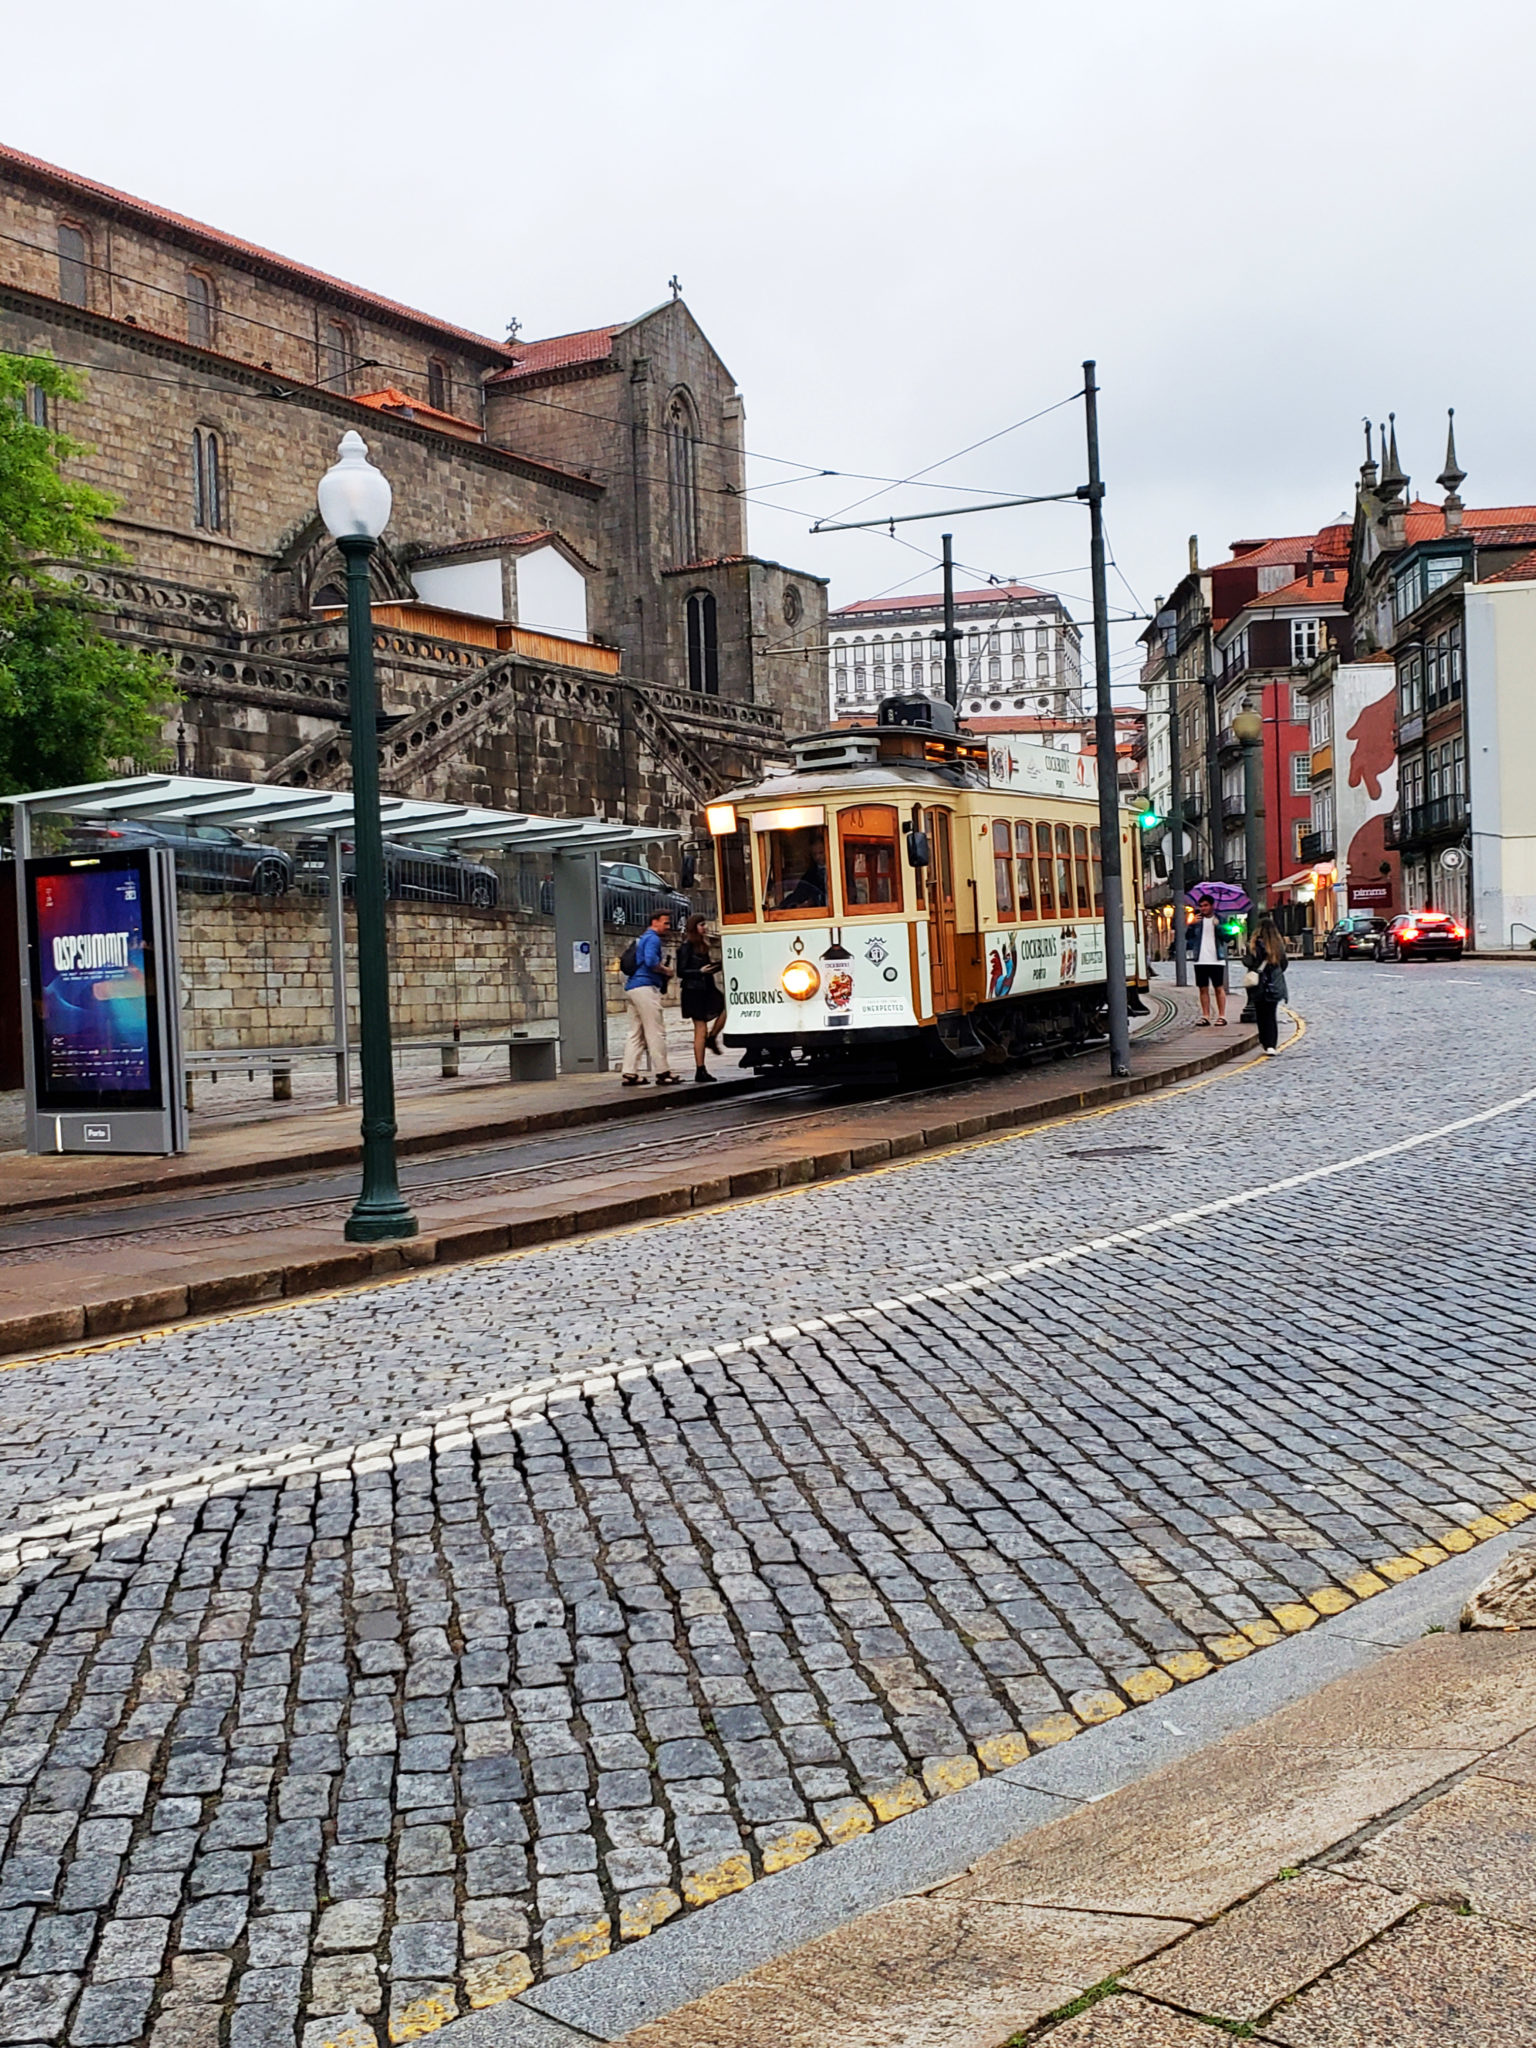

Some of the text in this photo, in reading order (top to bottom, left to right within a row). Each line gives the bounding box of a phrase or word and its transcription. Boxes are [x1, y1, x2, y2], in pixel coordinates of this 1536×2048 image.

[1353, 887, 1387, 900] pimms
[727, 947, 744, 959] 216
[1021, 934, 1057, 960] COCKBURN'S
[740, 1010, 761, 1018] PORTO
[862, 1004, 904, 1013] UNEXPECTED
